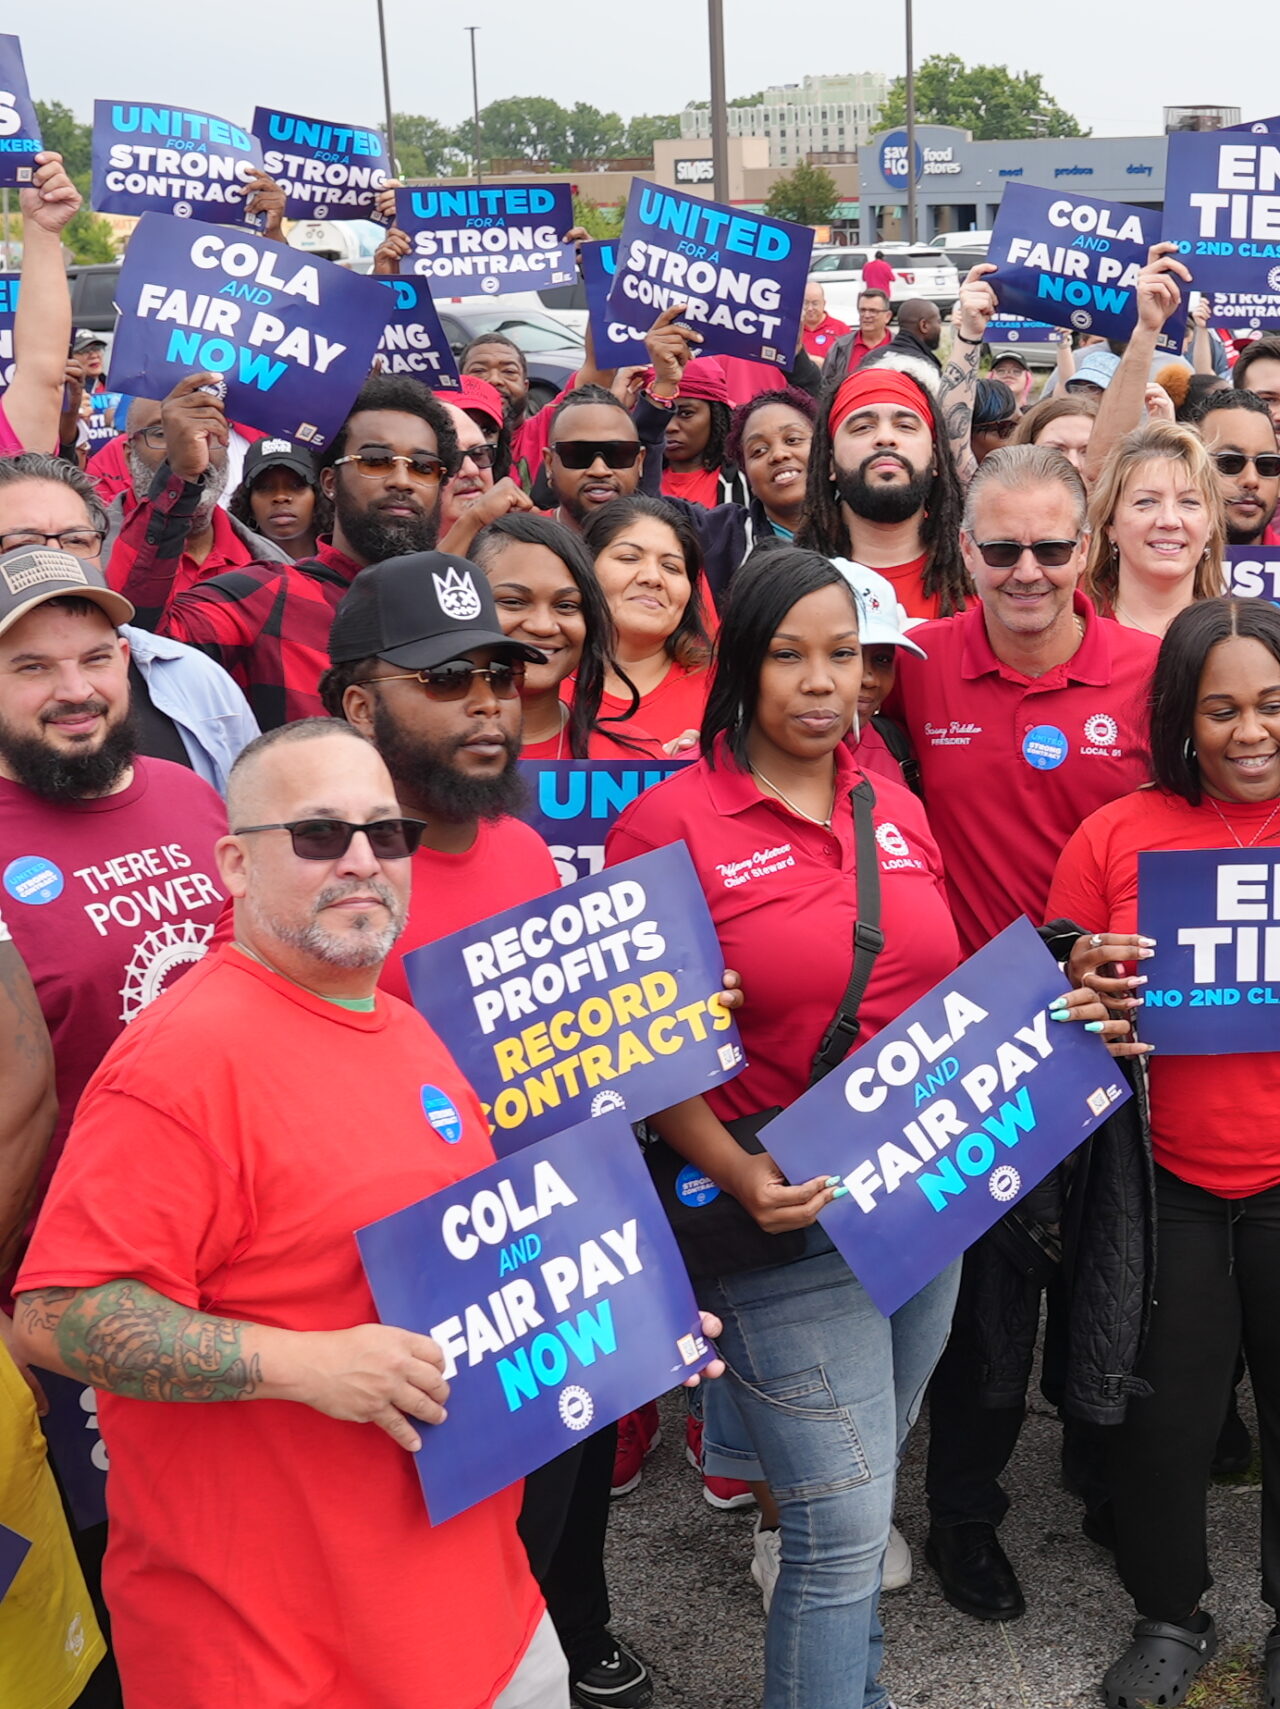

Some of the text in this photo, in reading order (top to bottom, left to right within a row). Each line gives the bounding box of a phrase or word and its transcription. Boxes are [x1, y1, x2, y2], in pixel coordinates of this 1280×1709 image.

[0, 138, 43, 152] KERS
[112, 105, 252, 152] UNITED
[166, 138, 207, 153] FOR A
[269, 114, 382, 157] UNITED
[264, 151, 387, 190] STRONG
[313, 151, 349, 164] FOR A
[884, 146, 908, 159] sav
[891, 159, 909, 175] lo
[923, 147, 952, 161] food
[923, 162, 961, 175] stores
[1054, 165, 1094, 178] produce
[1126, 164, 1152, 177] dairy
[270, 177, 381, 206] ONTRAC
[411, 188, 555, 219] UNITED
[414, 225, 558, 256] STRONG
[465, 217, 505, 228] FOR A
[639, 188, 791, 262] UNITED
[1048, 200, 1144, 244] COLA
[676, 240, 720, 264] FOR A
[1072, 234, 1111, 252] AND
[1196, 241, 1234, 256] 2ND
[190, 235, 320, 305] COLA
[414, 251, 562, 278] CONTRACT
[627, 239, 781, 311] STRONG
[1006, 238, 1143, 288] FAIR PA
[219, 280, 272, 306] AND
[1037, 273, 1130, 315] NOW
[137, 284, 241, 336] FAIR
[248, 312, 346, 373] PAY
[166, 329, 288, 392] NOW
[372, 351, 441, 375] RACT
[1080, 747, 1109, 756] LOCAL
[73, 843, 192, 894] THERE IS
[724, 856, 796, 888] Chief Steward
[881, 859, 916, 870] LOCAL
[84, 873, 225, 936] POWER
[462, 880, 646, 987] RECORD
[473, 921, 666, 1034] PROFITS
[1145, 990, 1183, 1008] NO
[1189, 989, 1240, 1006] 2ND
[493, 971, 678, 1082] RECORD
[845, 990, 989, 1113] COLA
[914, 1055, 960, 1108] AND
[842, 1009, 1054, 1215] FAIR PAY
[916, 1086, 1037, 1213] NOW
[442, 1160, 578, 1261] COLA
[498, 1232, 542, 1278] AND
[429, 1218, 644, 1382] FAIR PAY
[495, 1298, 618, 1412] NOW
